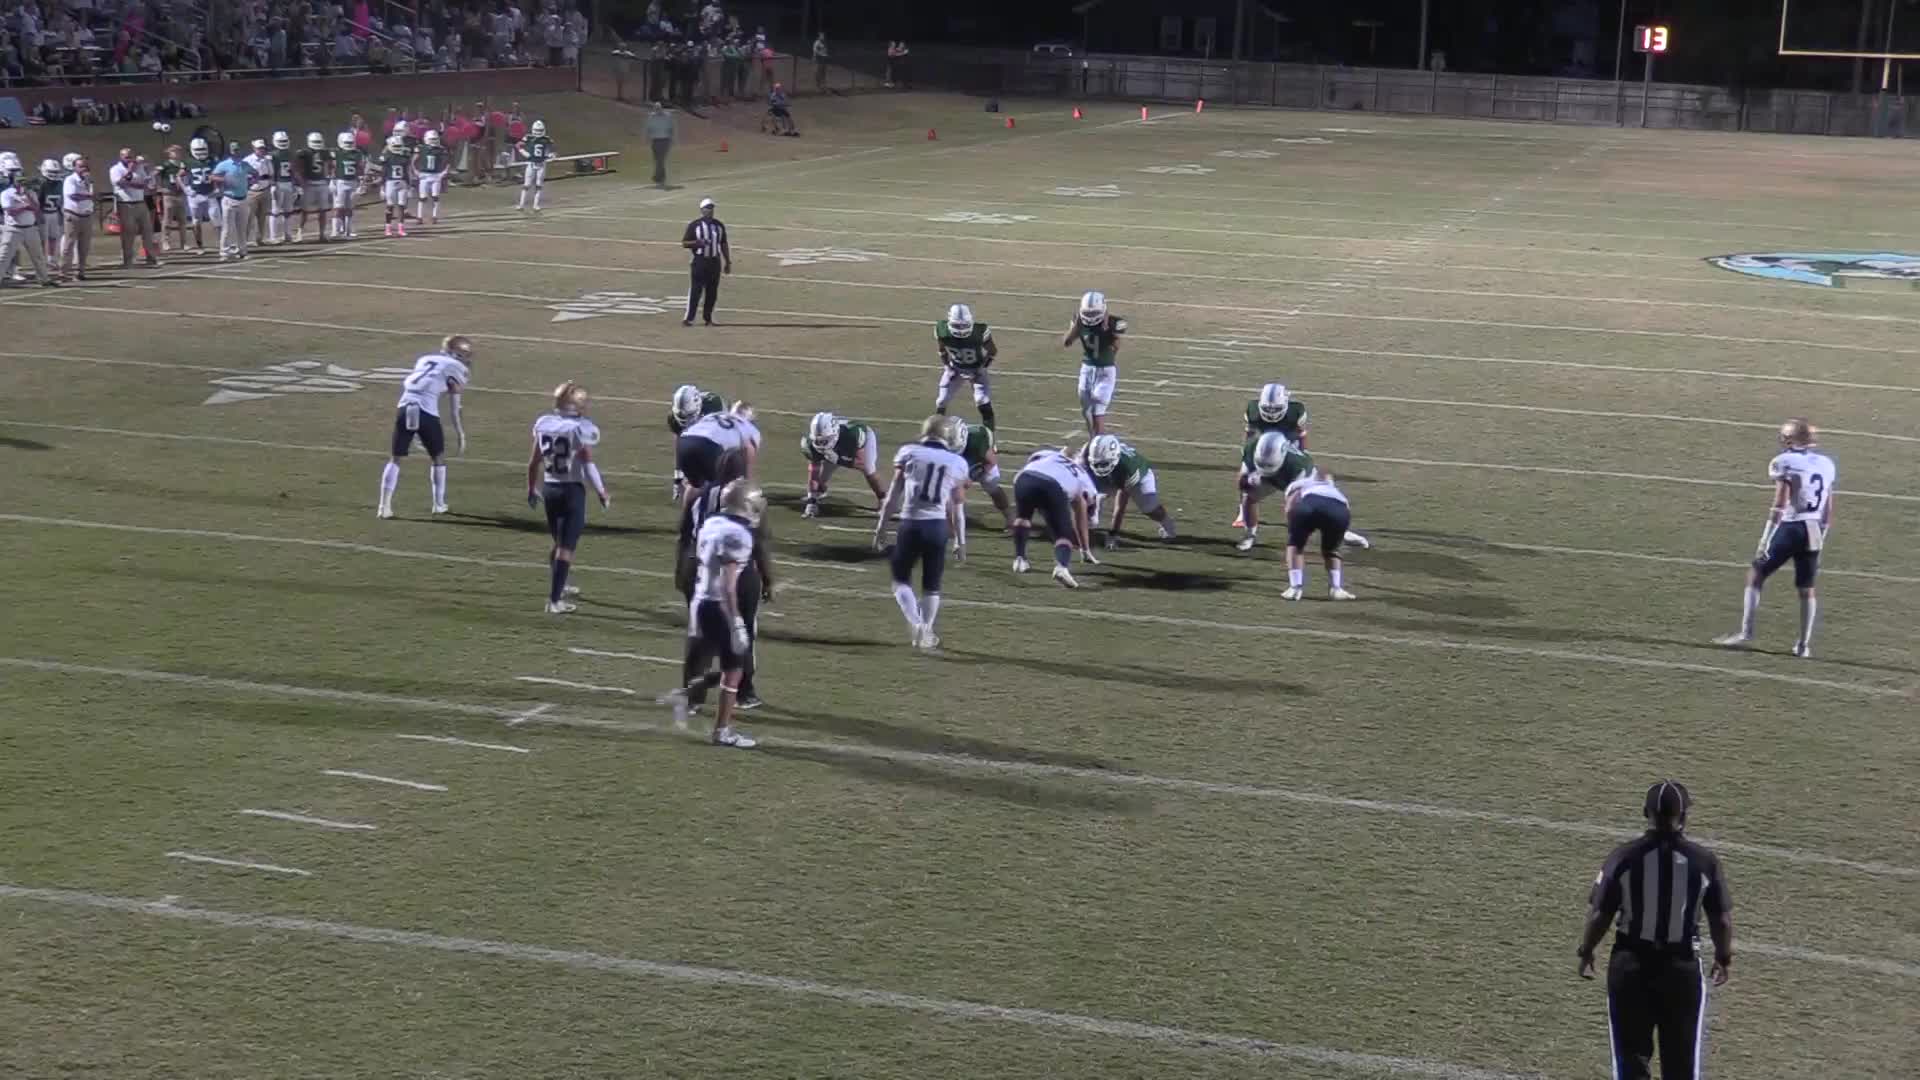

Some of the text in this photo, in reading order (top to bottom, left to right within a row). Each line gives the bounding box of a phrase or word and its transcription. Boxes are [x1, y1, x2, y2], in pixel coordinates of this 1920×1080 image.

[1643, 27, 1668, 51] 13
[534, 143, 544, 157] 6
[1083, 335, 1100, 359] 4
[412, 361, 438, 384] 7
[541, 434, 571, 475] 22
[922, 462, 947, 504] 11
[1807, 473, 1824, 512] 3
